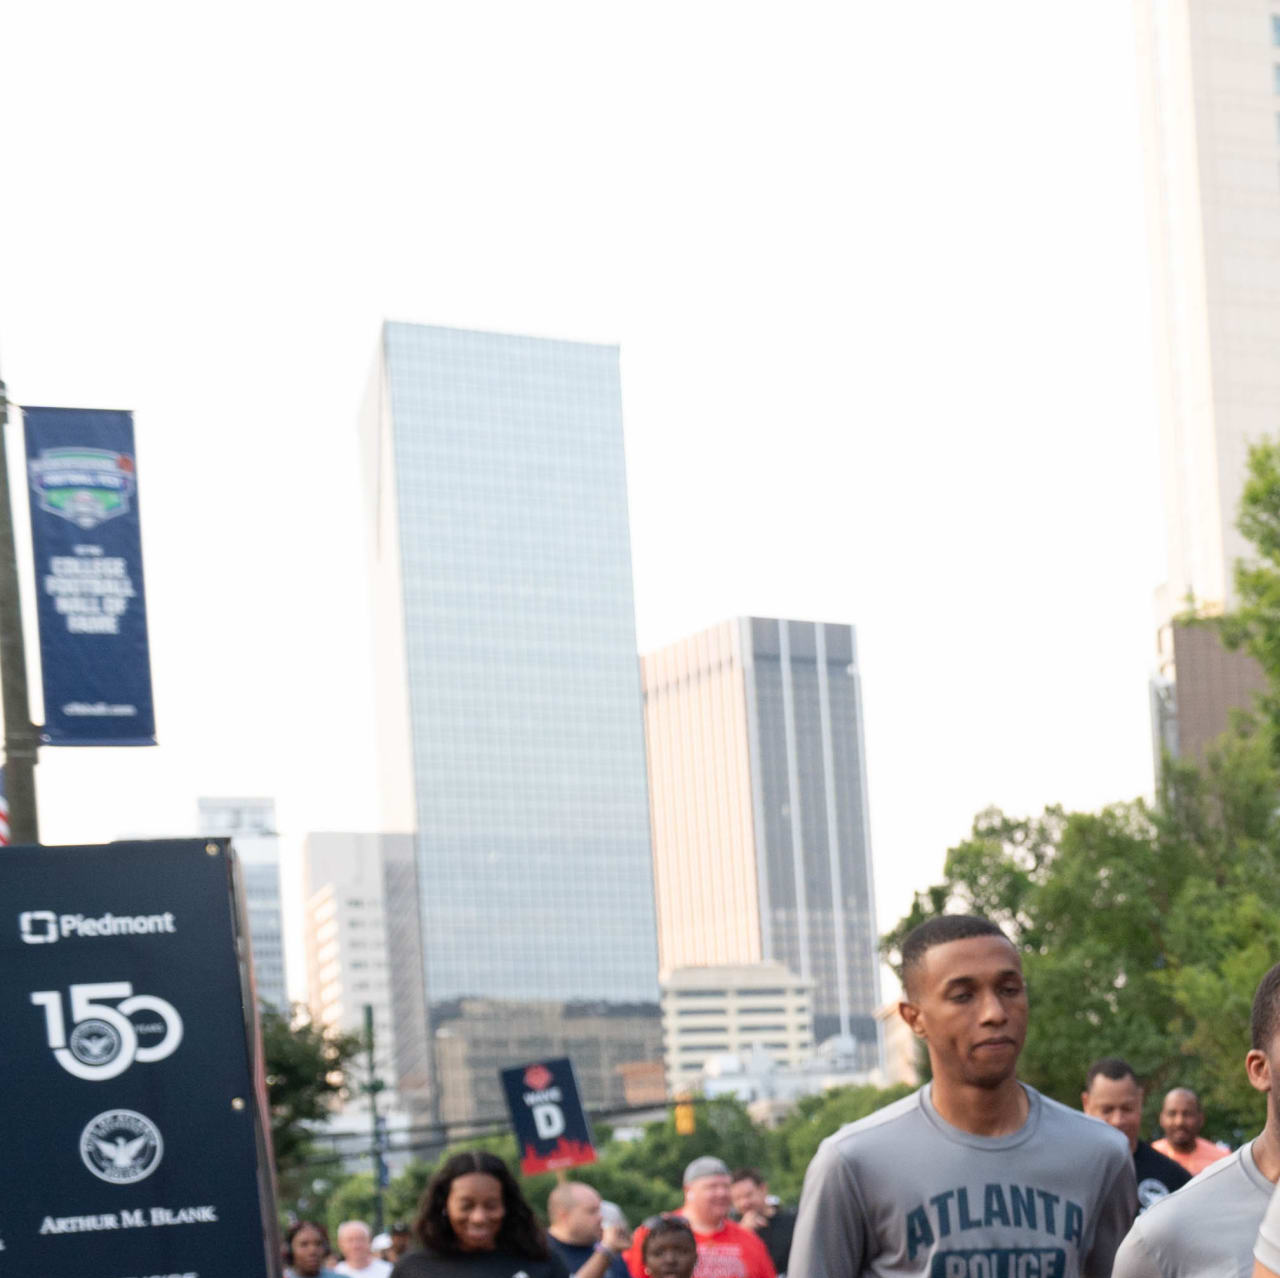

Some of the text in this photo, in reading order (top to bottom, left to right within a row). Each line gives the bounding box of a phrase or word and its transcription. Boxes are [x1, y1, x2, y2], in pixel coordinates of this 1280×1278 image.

[60, 912, 176, 937] Piedmont
[30, 981, 184, 1081] 150
[532, 1103, 566, 1140] D
[39, 1213, 119, 1235] ARTHUR
[150, 1205, 218, 1226] BLANK
[906, 1183, 1084, 1260] ATLANTA
